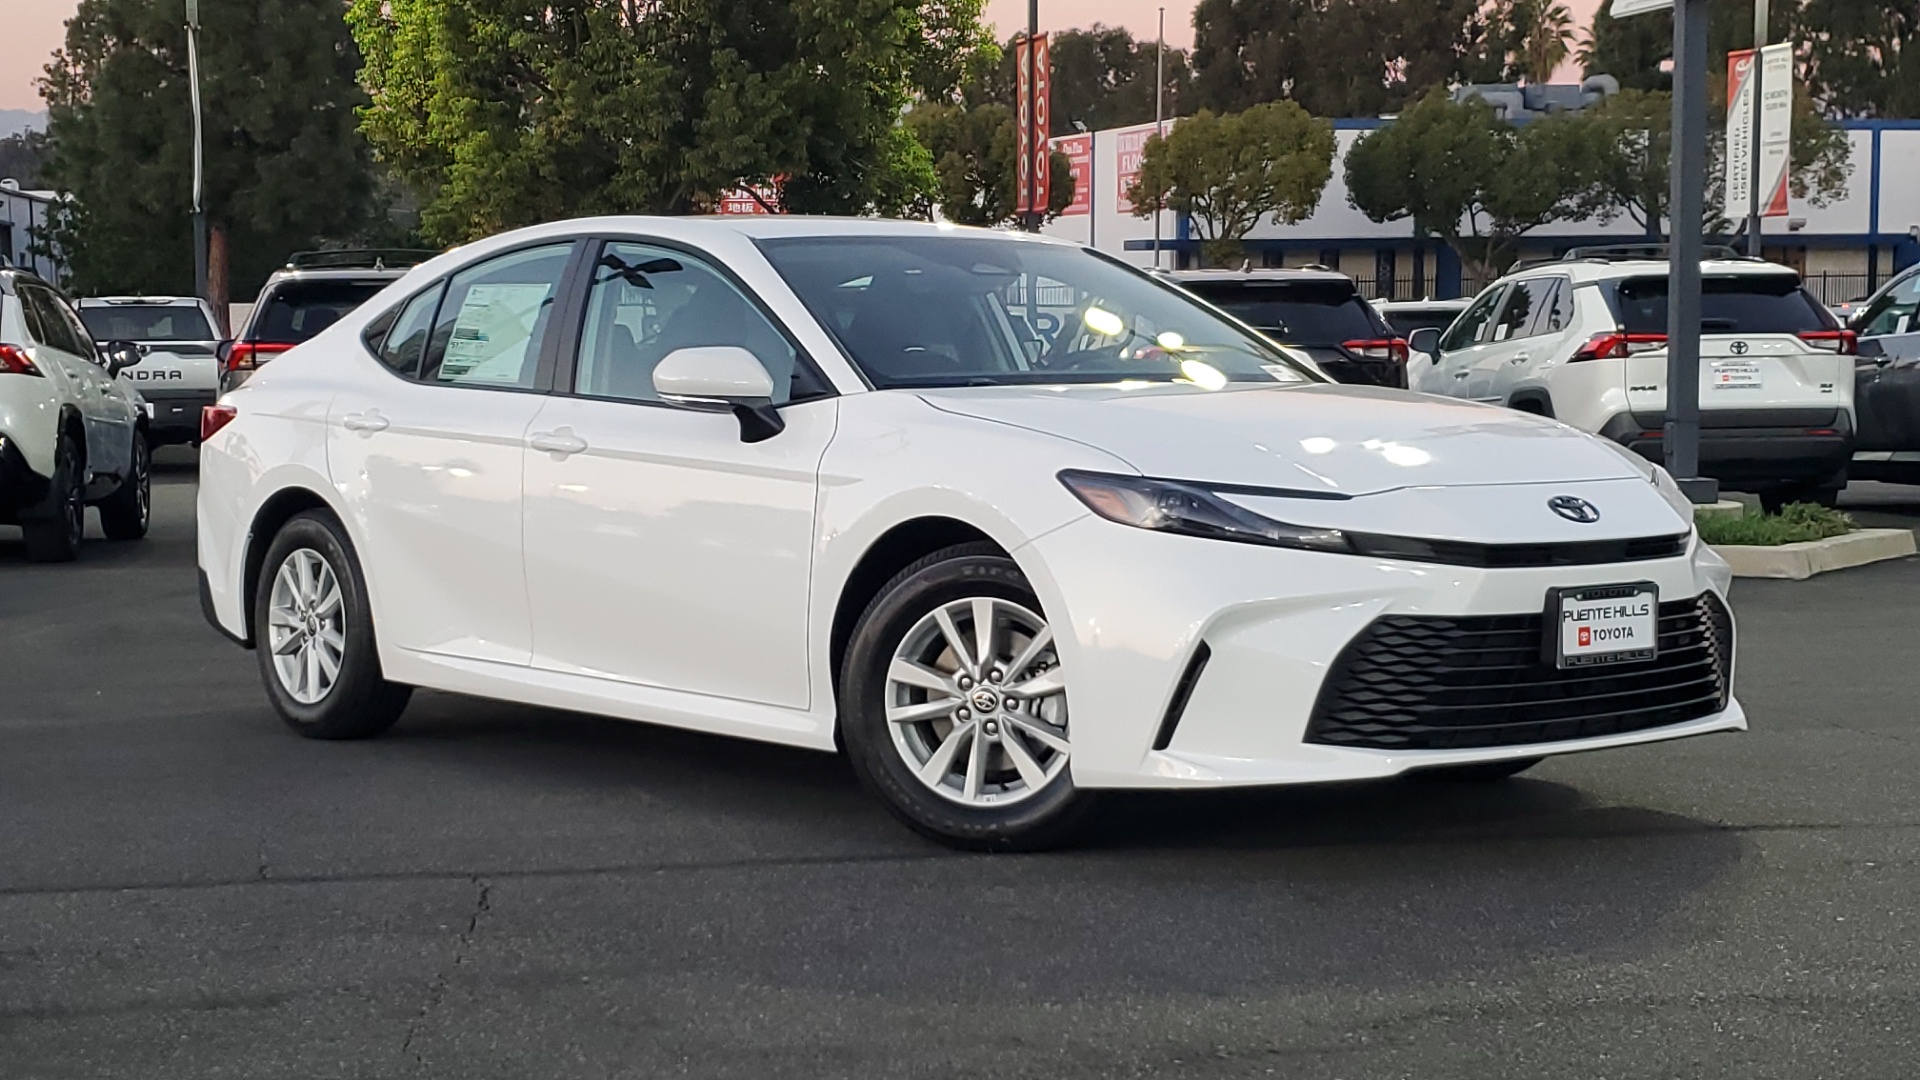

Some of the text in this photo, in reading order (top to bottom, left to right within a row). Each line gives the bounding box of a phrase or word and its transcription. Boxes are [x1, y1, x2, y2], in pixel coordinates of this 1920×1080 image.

[1020, 48, 1028, 204] TOYOTA
[1036, 46, 1045, 204] TOYOTA
[1741, 88, 1750, 158] VEHICLES
[1732, 126, 1740, 202] CERTIFIED
[121, 370, 183, 381] NDRA
[1563, 603, 1650, 622] PUENTE HILLS
[1593, 626, 1634, 641] TOYOTA
[1567, 654, 1614, 666] PUENTE
